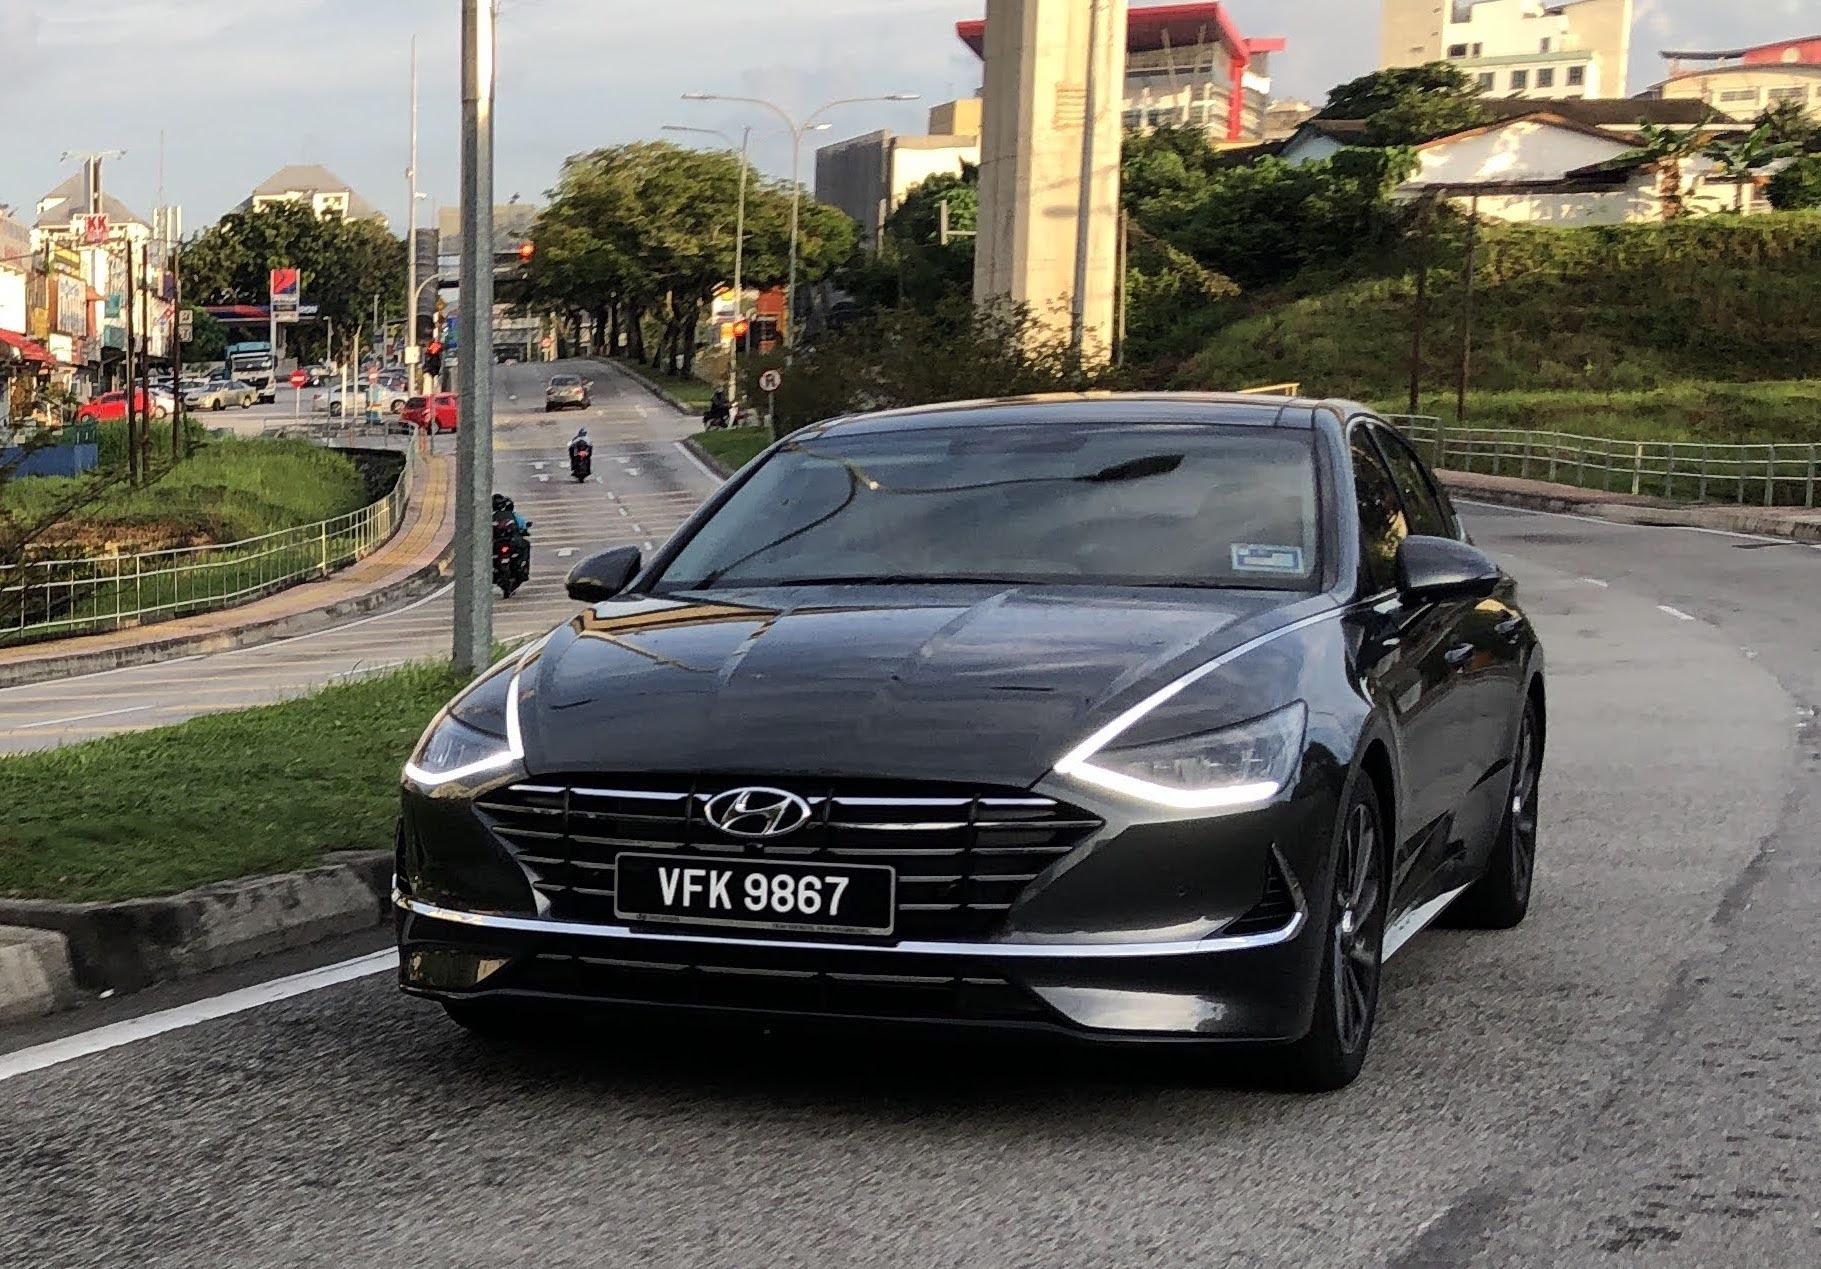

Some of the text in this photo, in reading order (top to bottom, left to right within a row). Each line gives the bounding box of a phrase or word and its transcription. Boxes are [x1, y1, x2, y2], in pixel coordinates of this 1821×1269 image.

[87, 215, 106, 231] KK
[657, 866, 850, 917] VFK 9867
